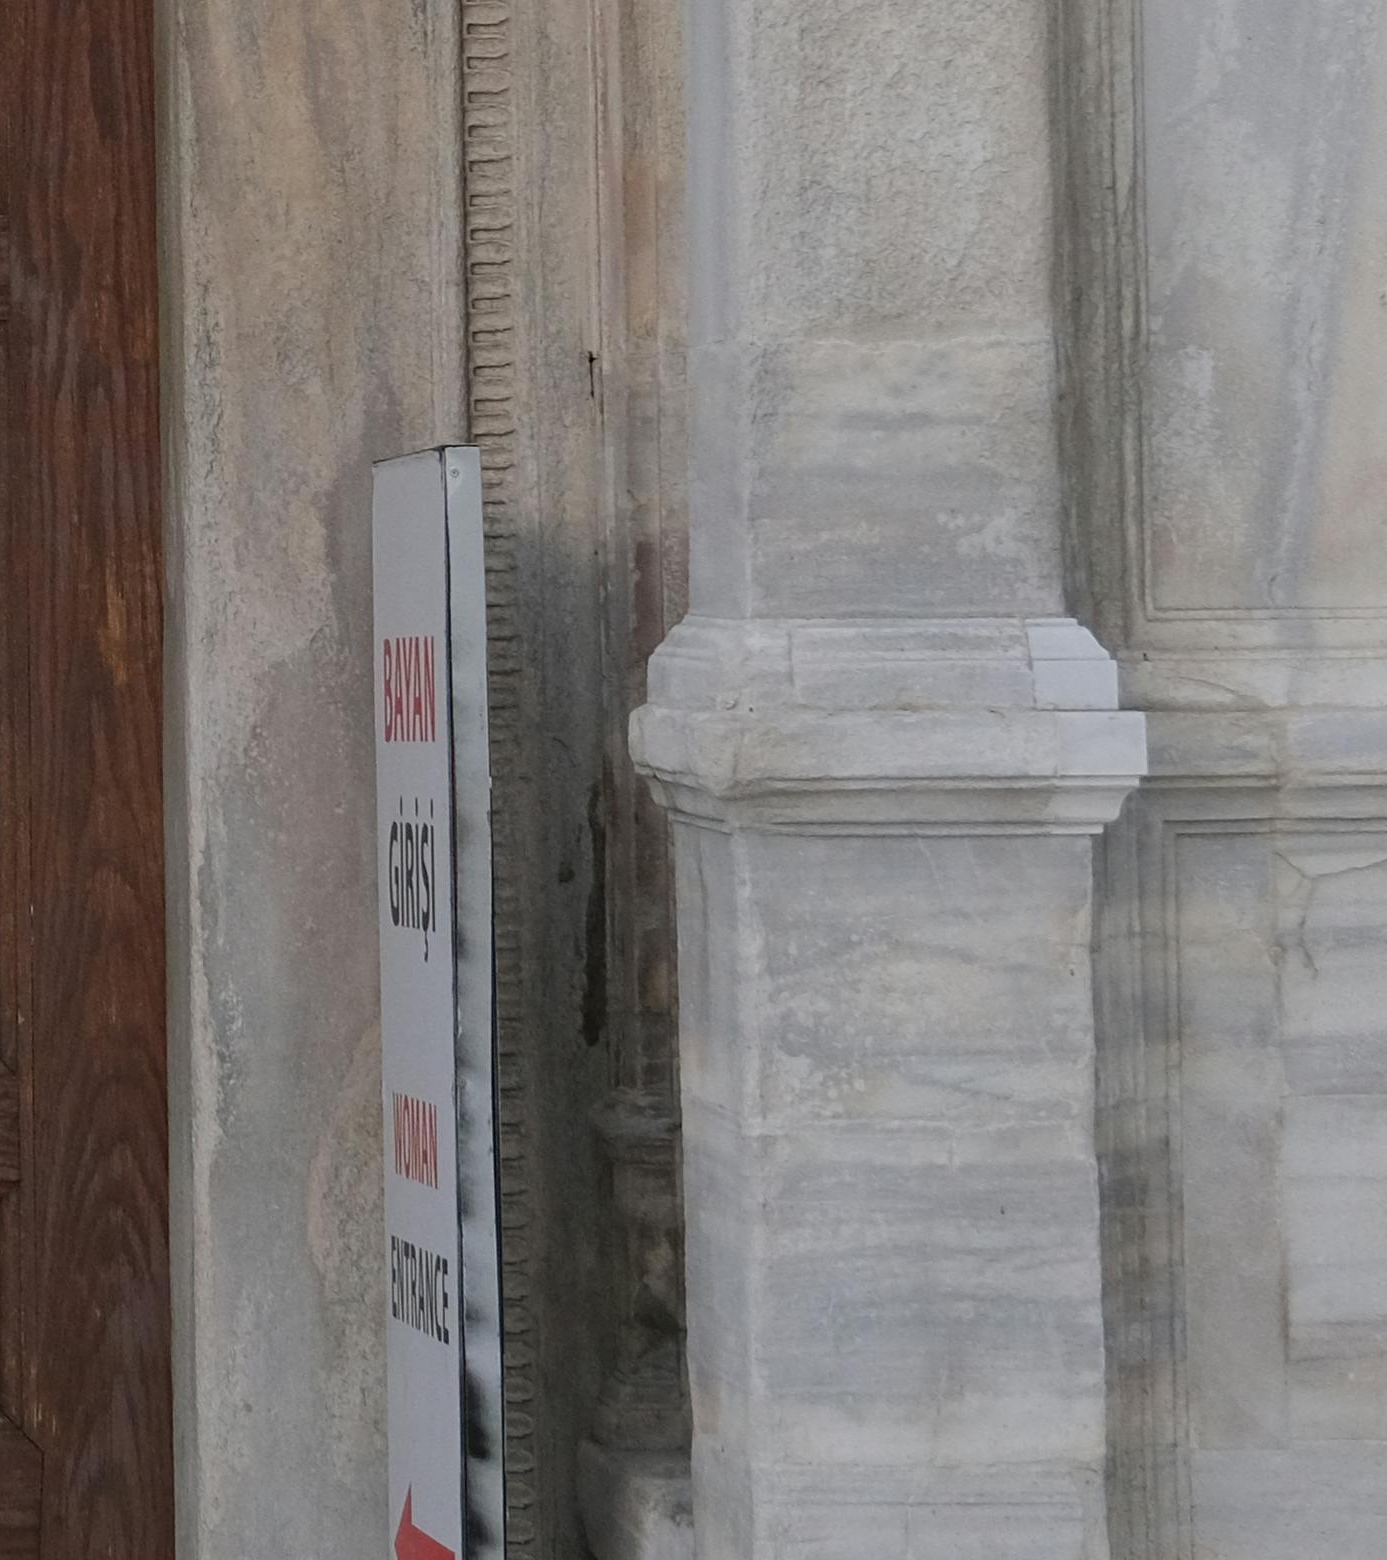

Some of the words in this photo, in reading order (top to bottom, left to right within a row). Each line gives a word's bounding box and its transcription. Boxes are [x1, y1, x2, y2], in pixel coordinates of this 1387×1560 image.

[383, 635, 437, 744] BAYAN
[388, 795, 437, 963] GİRİŞİ
[391, 1091, 439, 1190] WOMAN
[390, 1234, 450, 1346] ENTRANCE
